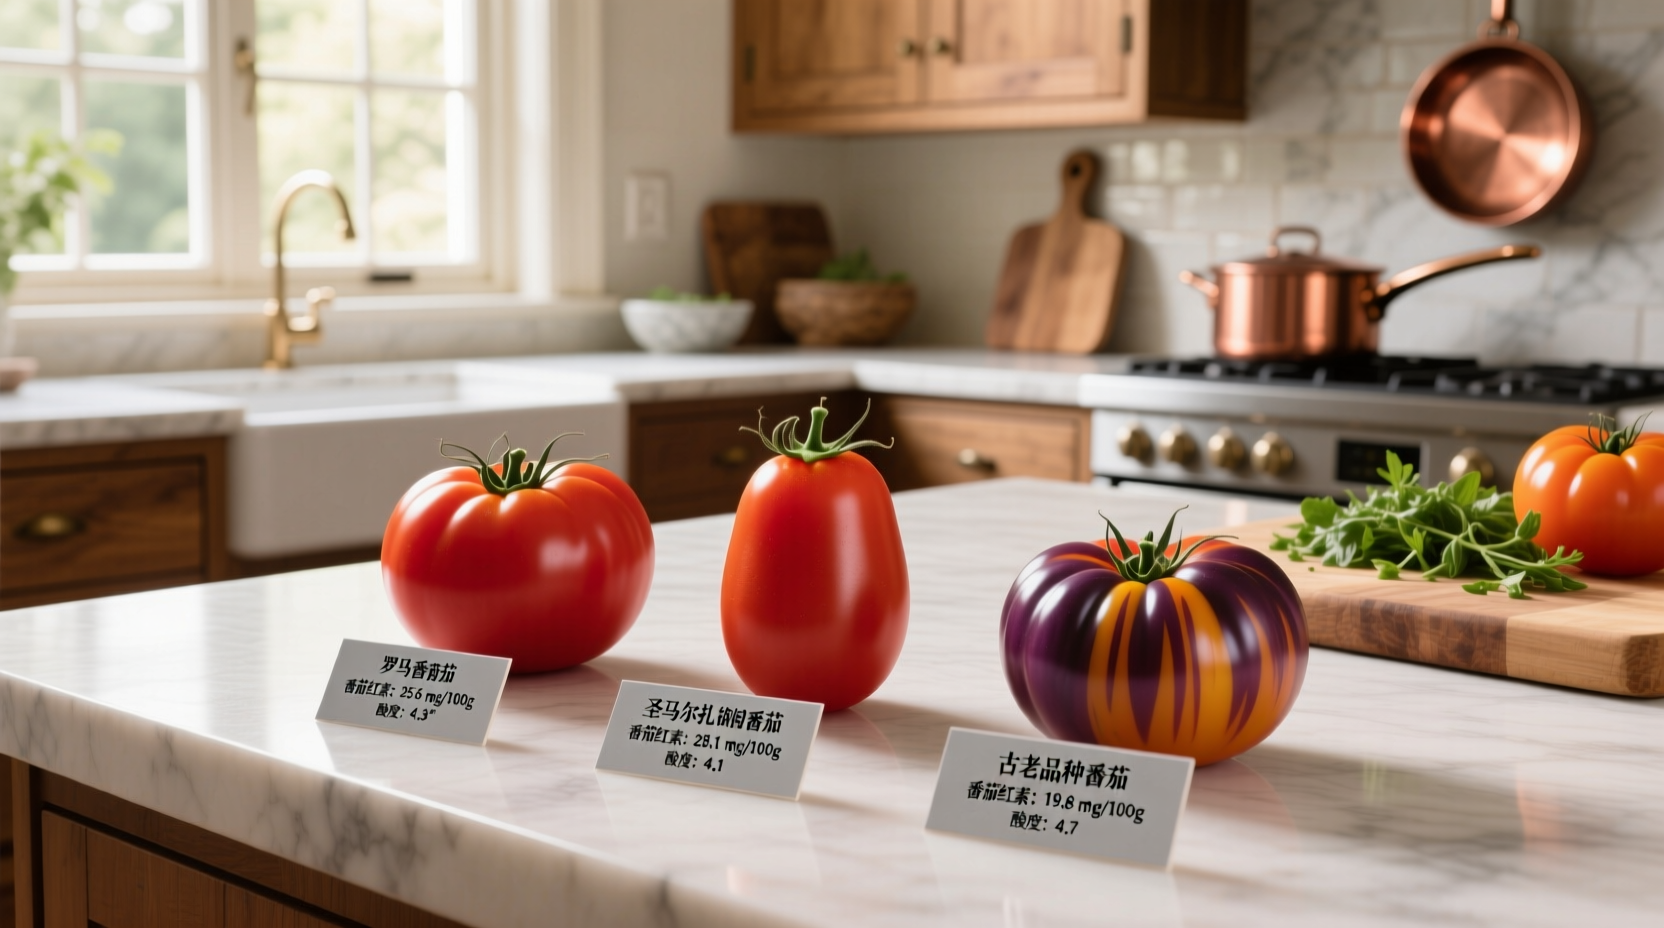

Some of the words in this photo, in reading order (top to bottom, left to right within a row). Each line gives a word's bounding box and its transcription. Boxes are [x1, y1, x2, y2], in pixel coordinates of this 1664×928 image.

[425, 690, 475, 711] mg/100g
[693, 733, 720, 750] 28.1
[725, 740, 781, 762] mg/100g
[704, 757, 724, 773] 4.1
[1000, 751, 1131, 791] 古老品种番茄
[1046, 792, 1074, 810] 19.8
[1078, 801, 1146, 825] mg/100g
[1054, 819, 1078, 836] 4.7
